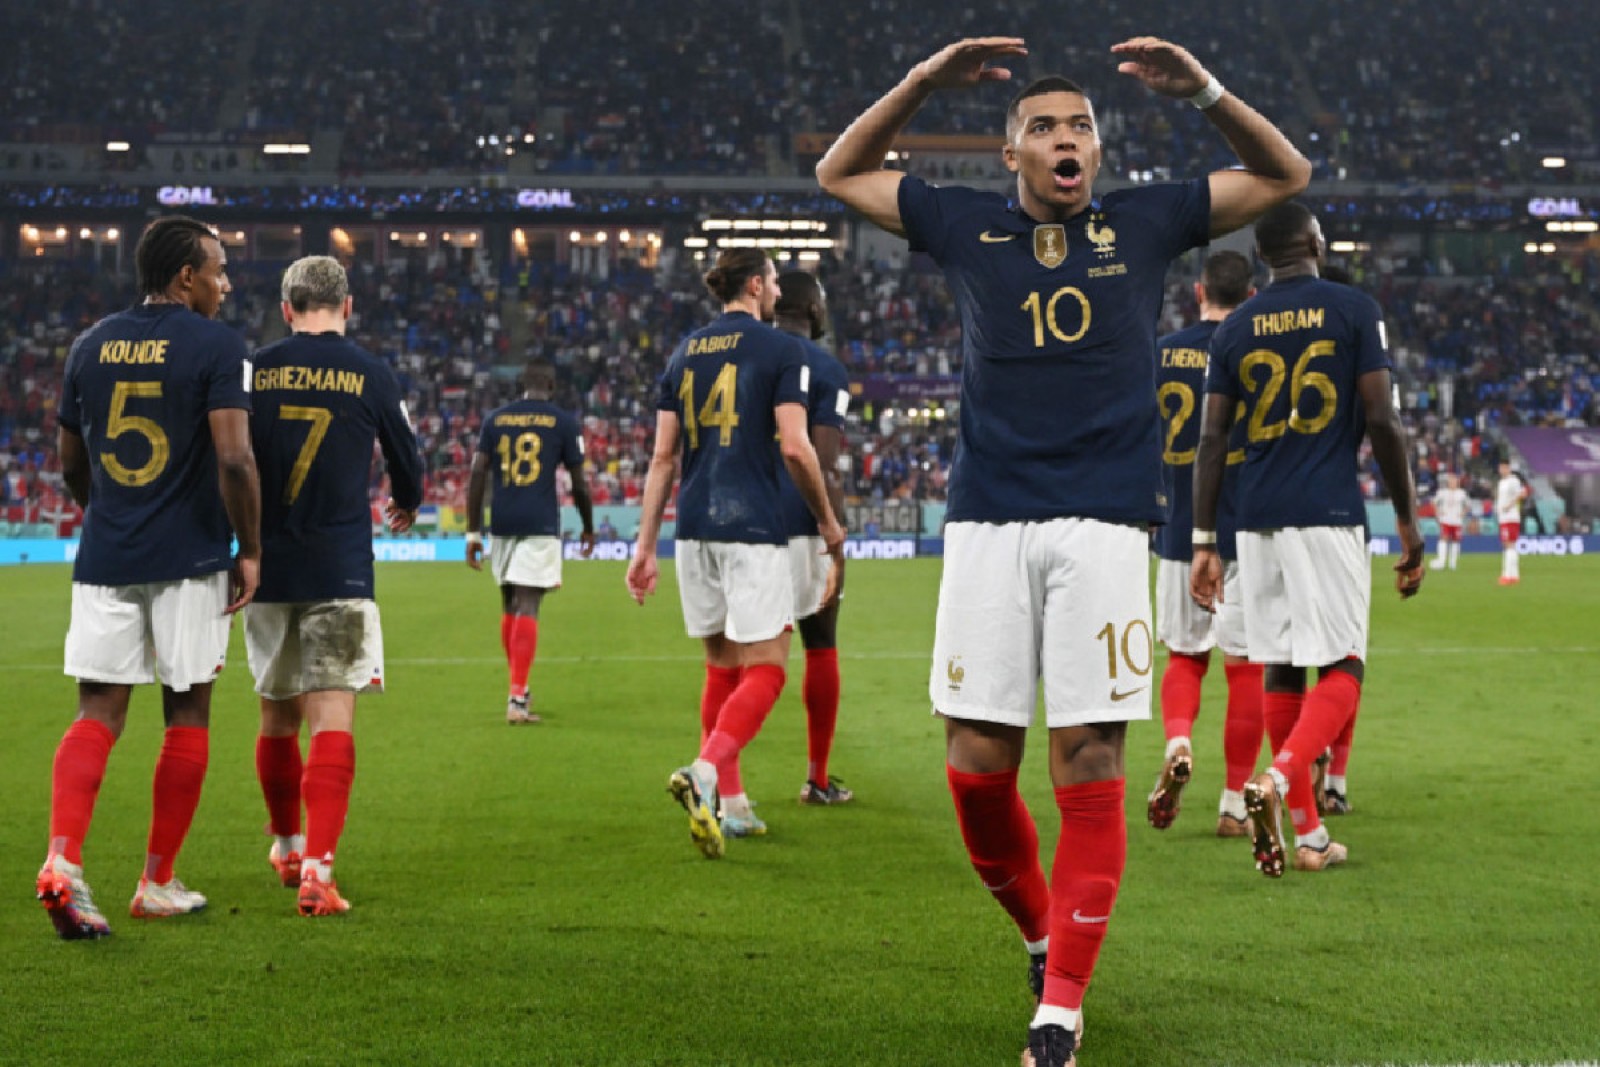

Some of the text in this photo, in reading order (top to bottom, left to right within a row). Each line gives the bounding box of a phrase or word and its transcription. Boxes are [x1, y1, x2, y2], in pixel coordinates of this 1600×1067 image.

[156, 186, 217, 205] GOAL
[517, 188, 576, 208] GOAL
[1528, 198, 1584, 216] GOAL
[1021, 286, 1092, 347] 10
[1252, 308, 1325, 336] THURAM
[100, 340, 169, 364] KOUNDE
[686, 332, 743, 356] RABIOT
[1162, 348, 1208, 368] T.HERN
[255, 366, 365, 398] GRIEZMANN
[1239, 339, 1337, 443] 26
[679, 362, 739, 449] 14
[100, 381, 170, 487] 5
[279, 404, 334, 505] 7
[496, 431, 542, 488] 18
[843, 540, 917, 559] YUNDA
[1096, 618, 1153, 680] 10
